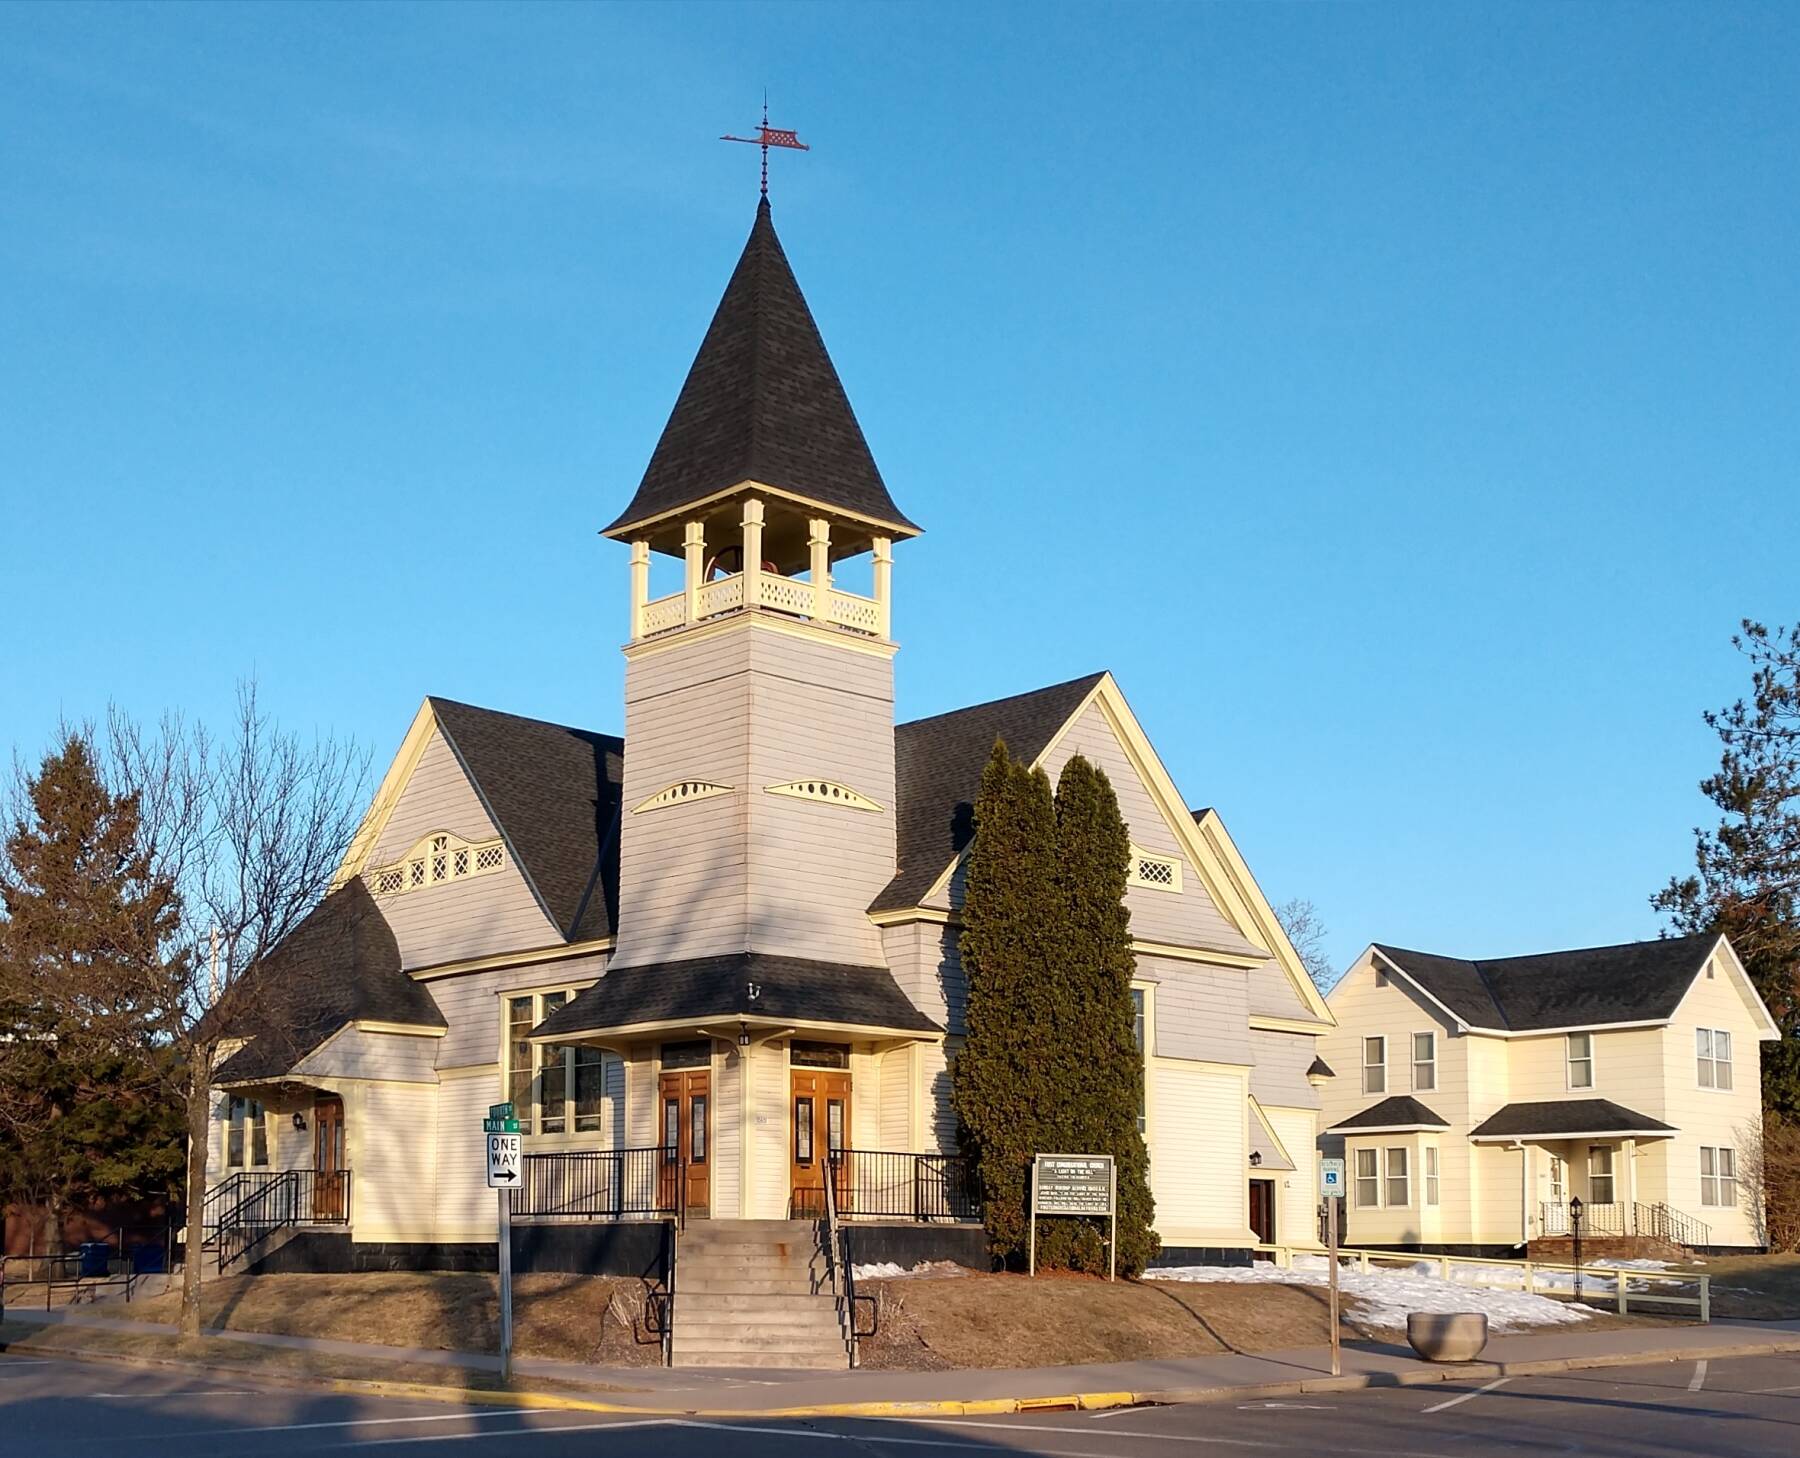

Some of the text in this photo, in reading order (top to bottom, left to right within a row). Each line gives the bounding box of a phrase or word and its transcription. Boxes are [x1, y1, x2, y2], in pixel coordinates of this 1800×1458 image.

[486, 1120, 505, 1131] MAIN
[491, 1138, 517, 1151] ONE
[491, 1153, 518, 1166] WAY
